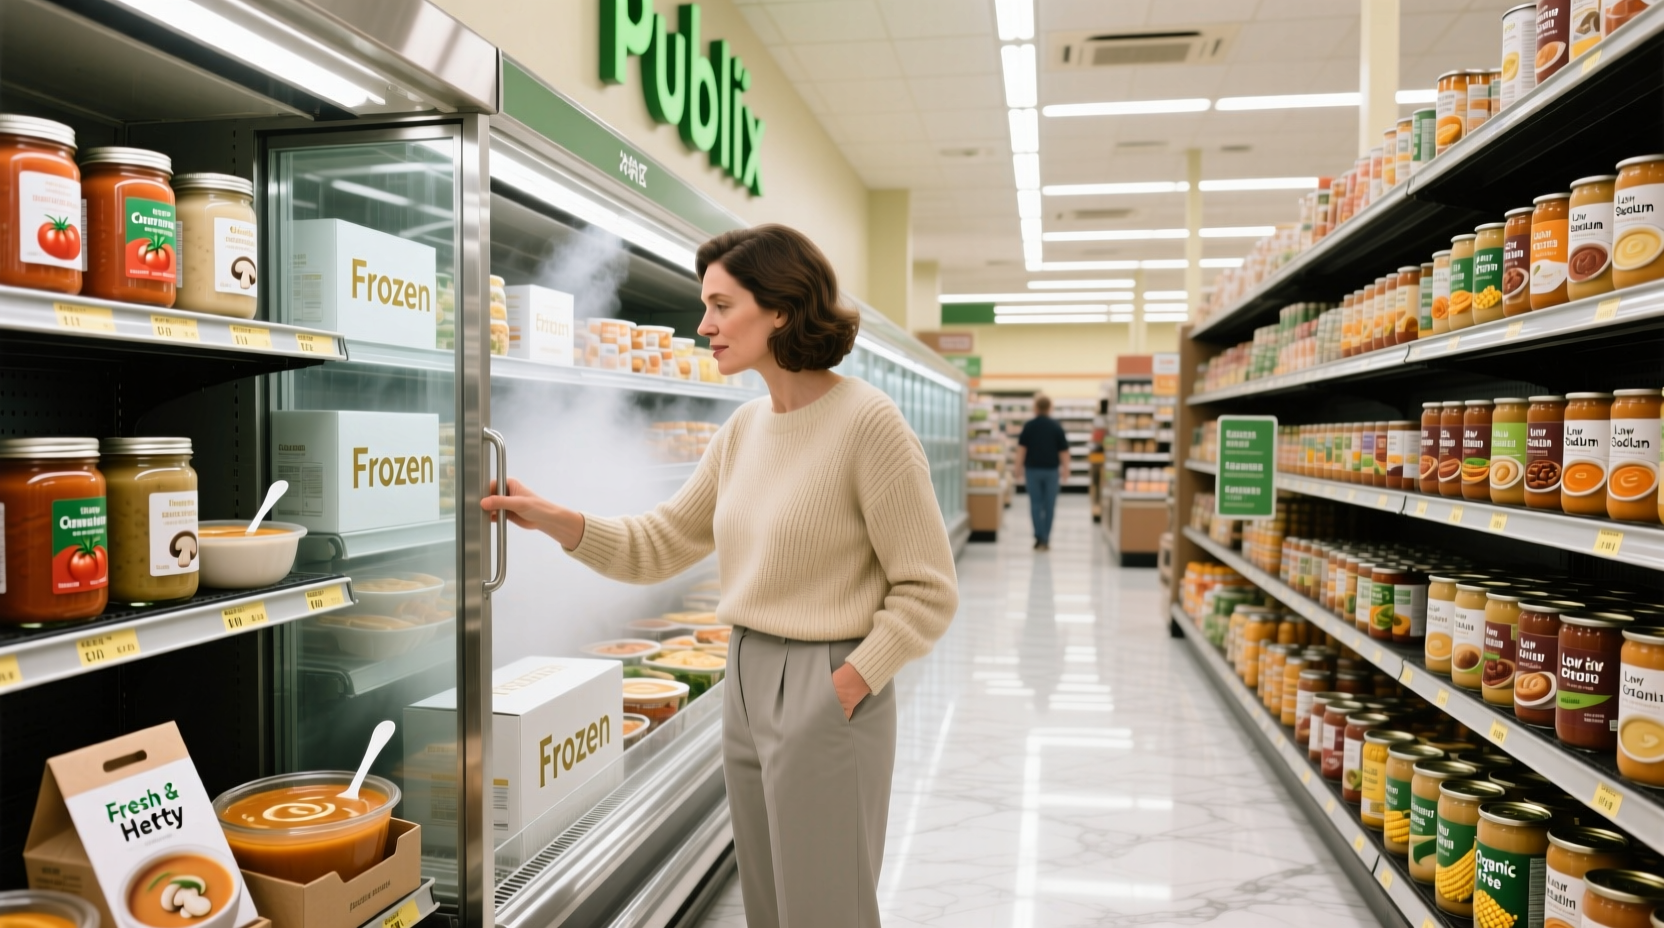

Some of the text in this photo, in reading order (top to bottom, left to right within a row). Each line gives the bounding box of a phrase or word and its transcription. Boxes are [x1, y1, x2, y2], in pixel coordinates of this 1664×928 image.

[598, 0, 765, 196] Publix
[351, 257, 431, 312] Frozen
[352, 446, 434, 489] Frozen
[539, 714, 611, 788] Frozen
[105, 782, 179, 823] Fresh &
